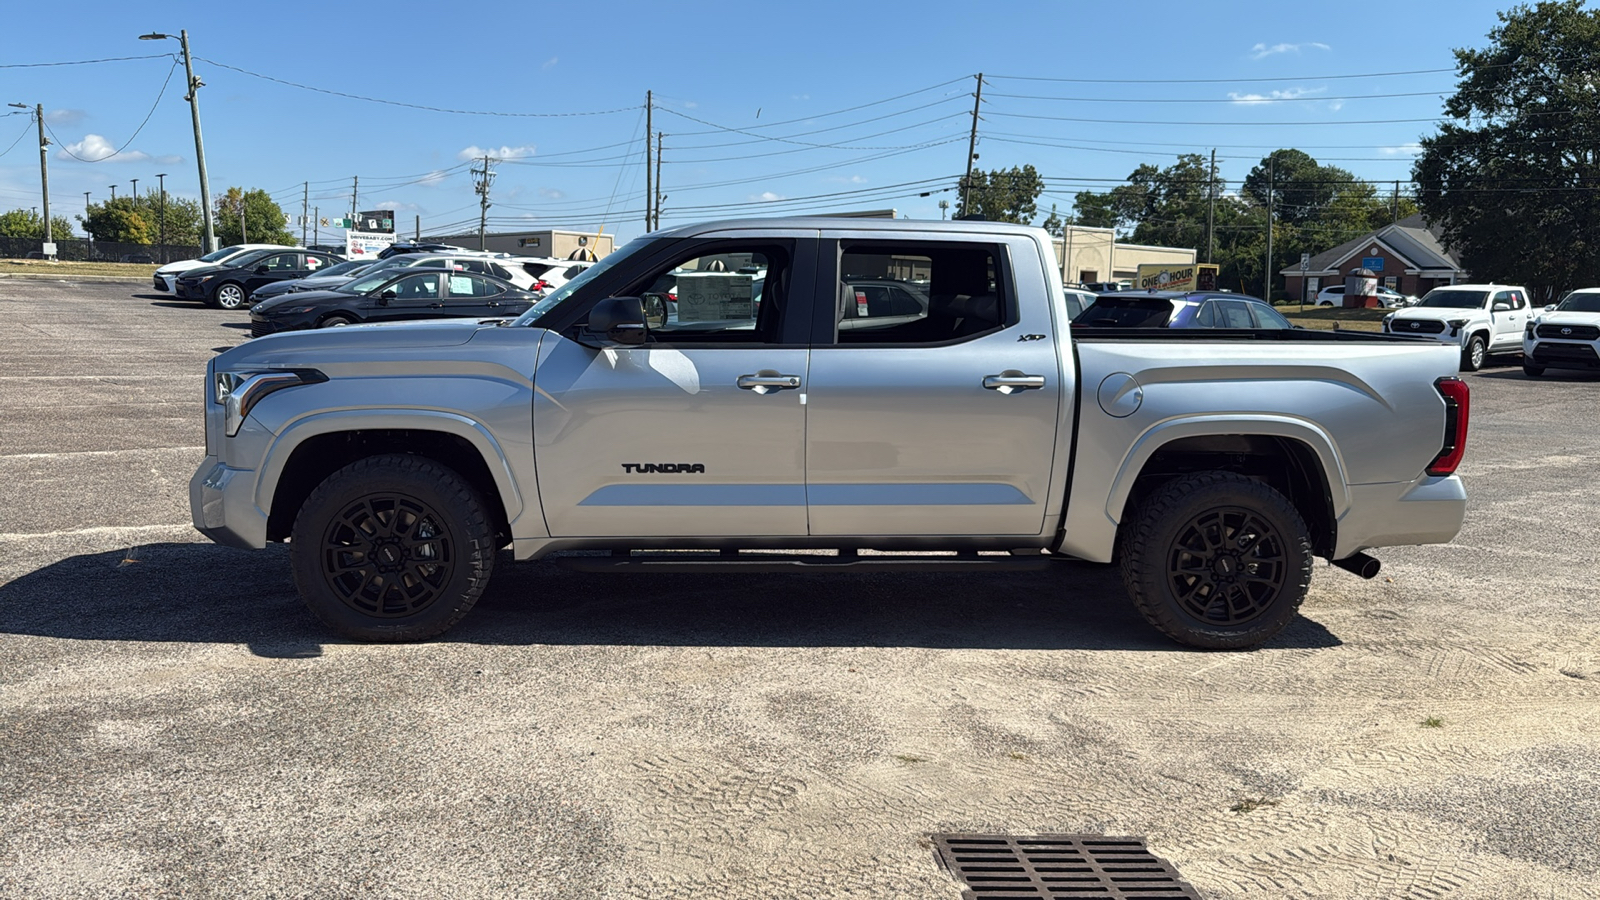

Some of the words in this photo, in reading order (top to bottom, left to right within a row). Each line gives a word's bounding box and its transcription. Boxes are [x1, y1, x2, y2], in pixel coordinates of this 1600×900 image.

[1141, 275, 1158, 288] ONE
[1169, 268, 1193, 281] HOUR
[621, 463, 705, 473] TUNDRA
